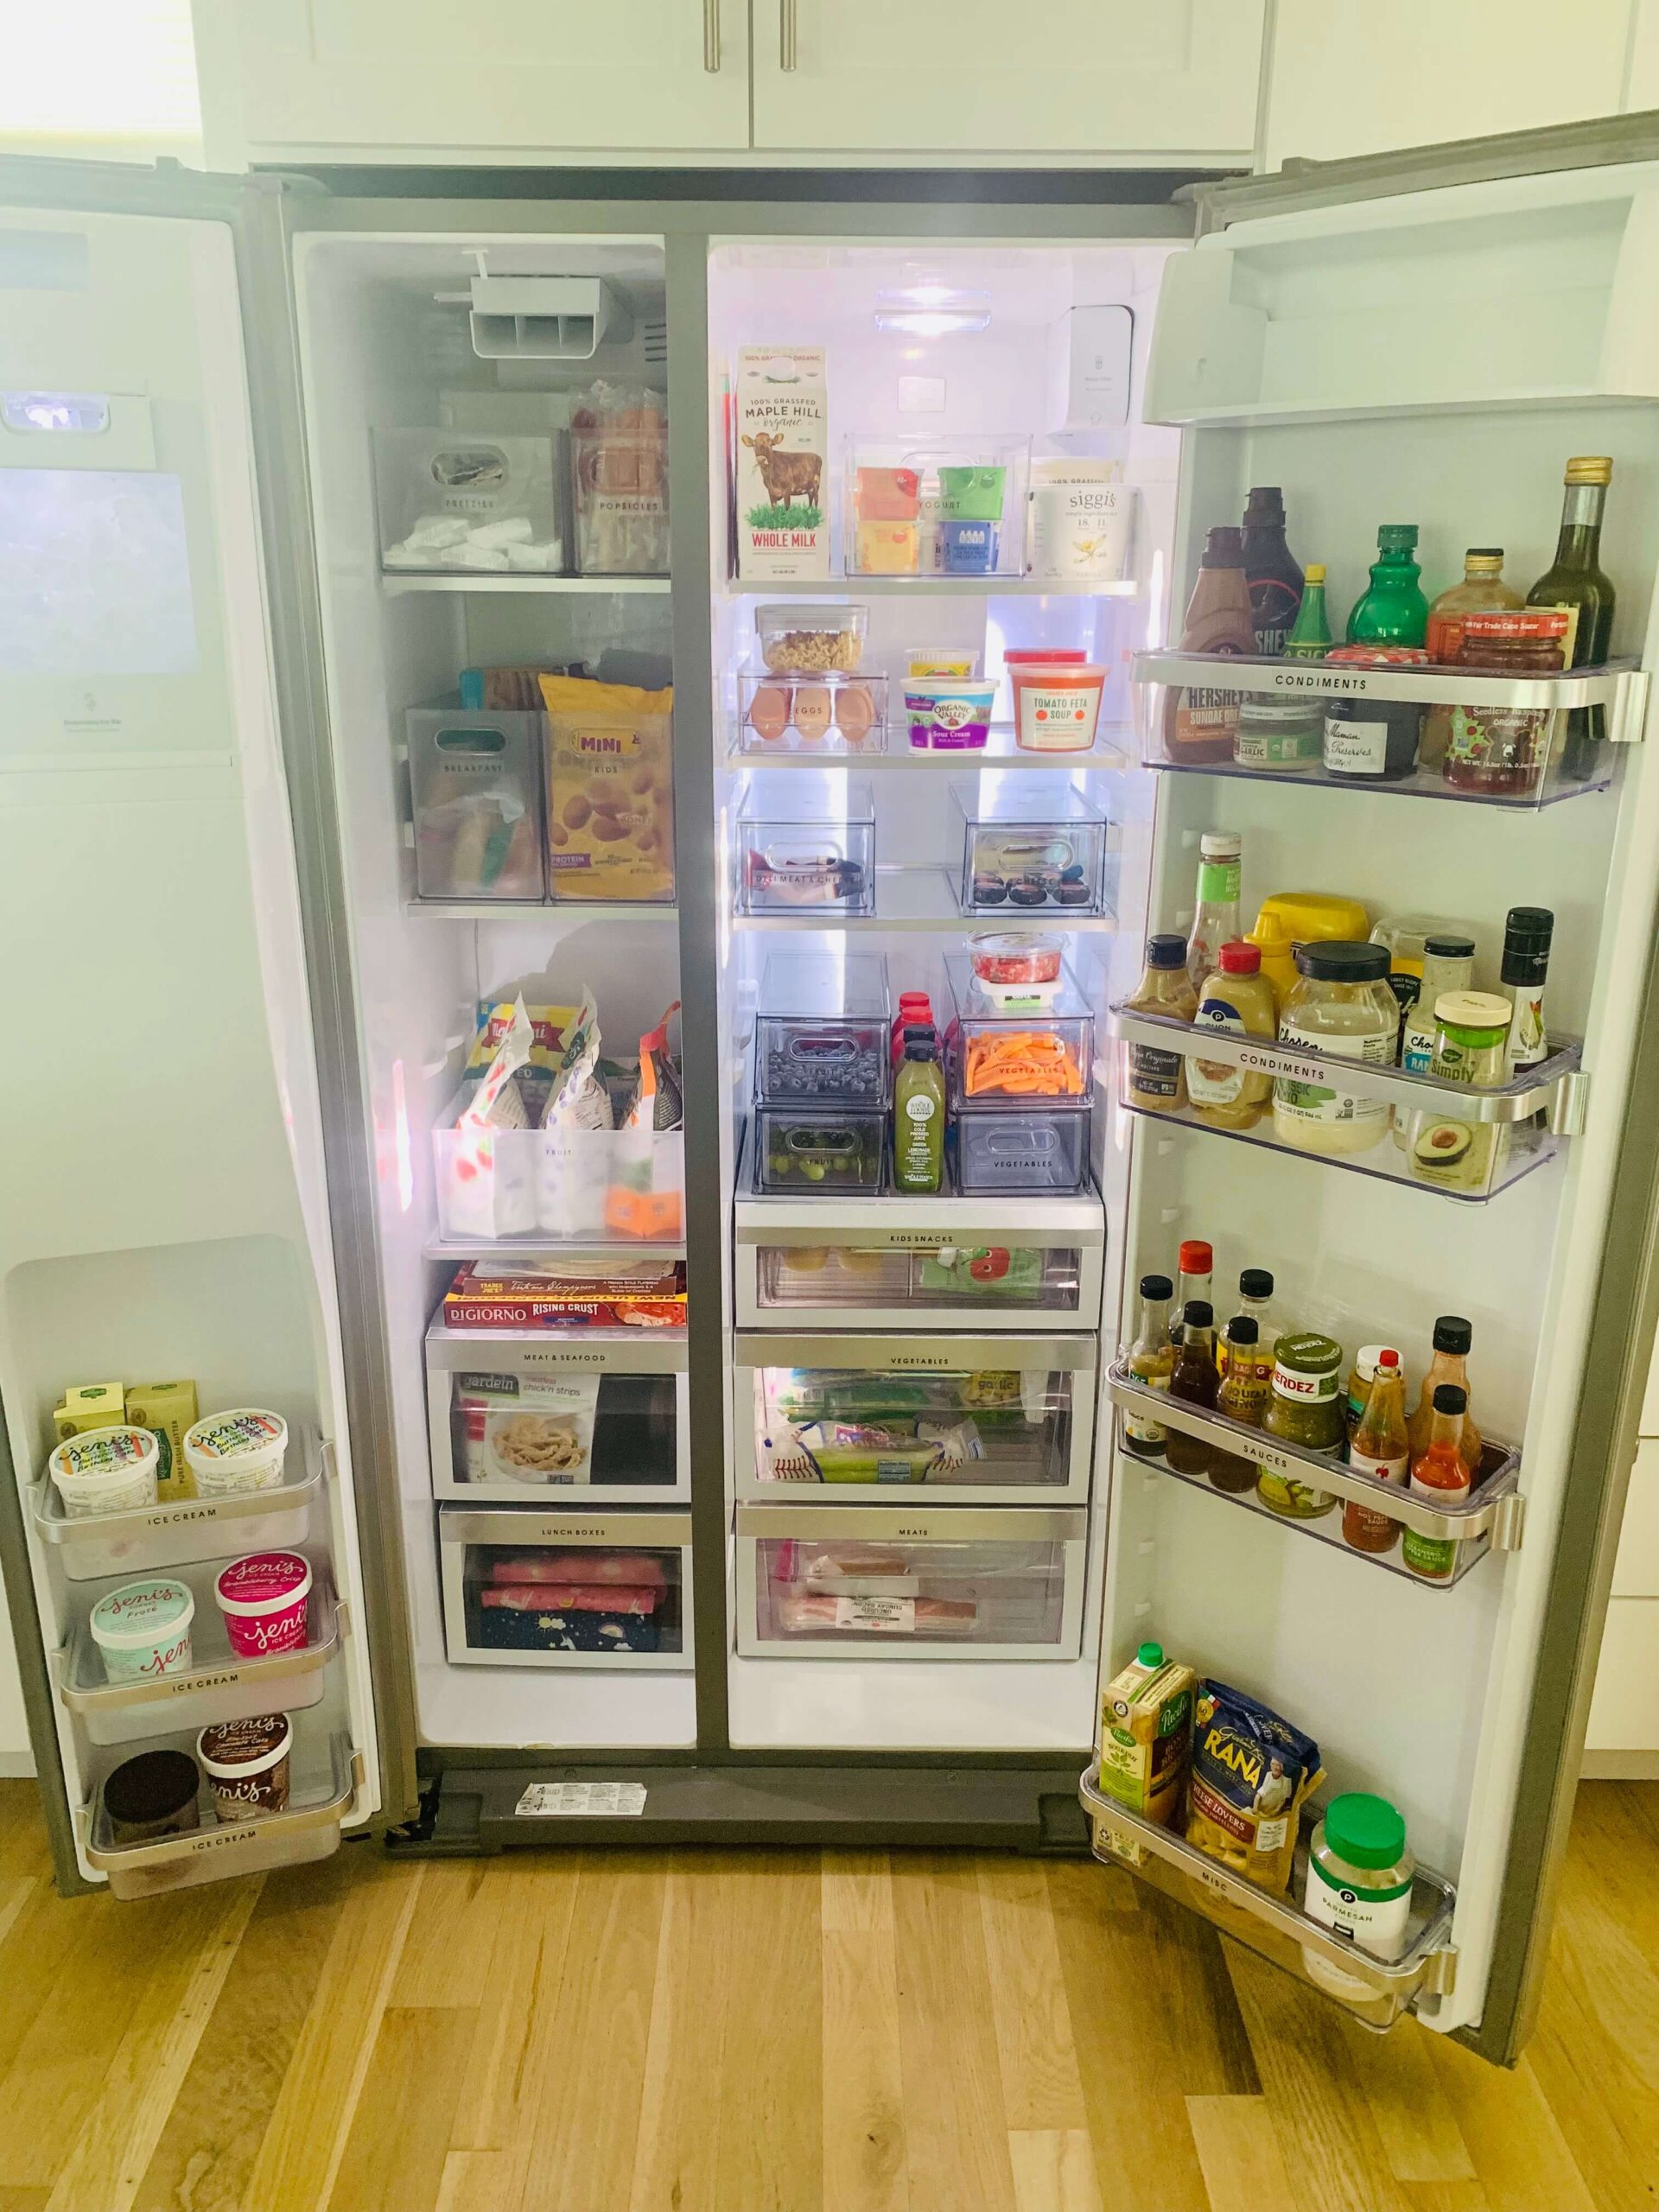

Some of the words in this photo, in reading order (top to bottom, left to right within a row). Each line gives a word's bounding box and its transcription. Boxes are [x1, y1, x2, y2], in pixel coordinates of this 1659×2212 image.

[773, 397, 816, 406] GRASSFED
[745, 406, 788, 419] MAPLE
[793, 406, 822, 419] HILL
[763, 417, 803, 432] organic
[600, 502, 658, 511] POPSICLES
[1070, 490, 1117, 510] siggi's
[752, 533, 788, 547] WHOLE
[791, 533, 817, 547] MILK
[1274, 674, 1368, 690] CONDIMENTS
[933, 703, 970, 714] ORGANIC
[1034, 697, 1067, 709] TOMATO
[1070, 697, 1088, 708] FETA
[1472, 706, 1508, 717] Seedless
[938, 710, 968, 720] VALLEY
[1050, 709, 1072, 719] SOUP
[1190, 709, 1224, 726] SUNDAE
[1493, 718, 1529, 727] ORGANIC
[580, 737, 621, 753] MINI
[1240, 1053, 1325, 1080] CONDIMENTS
[1431, 1058, 1476, 1084] Simply
[450, 1307, 527, 1322] DIGIORNO
[532, 1304, 565, 1316] RISING
[568, 1304, 599, 1316] CRUST
[465, 1375, 515, 1392] gardein
[523, 1382, 555, 1395] chick'n
[556, 1385, 582, 1397] strips
[172, 1421, 181, 1446] BUTTER
[191, 1416, 268, 1447] jeni's
[58, 1434, 145, 1462] jeni's
[175, 1447, 183, 1465] IRISH
[1243, 1445, 1287, 1467] SAUCES
[148, 1516, 168, 1525] ICE
[173, 1509, 216, 1522] CREAM
[227, 1560, 304, 1580] jeni's
[100, 1588, 183, 1614] jeni's
[173, 1683, 193, 1694] ICE
[196, 1674, 238, 1688] CREAM
[1204, 1728, 1262, 1790] RANA
[1212, 1803, 1246, 1831] LOVERS
[192, 1841, 212, 1850] ICE
[215, 1830, 257, 1847] CREAM
[1202, 1872, 1228, 1891] MISC
[1323, 1897, 1373, 1922] PARMESAN
